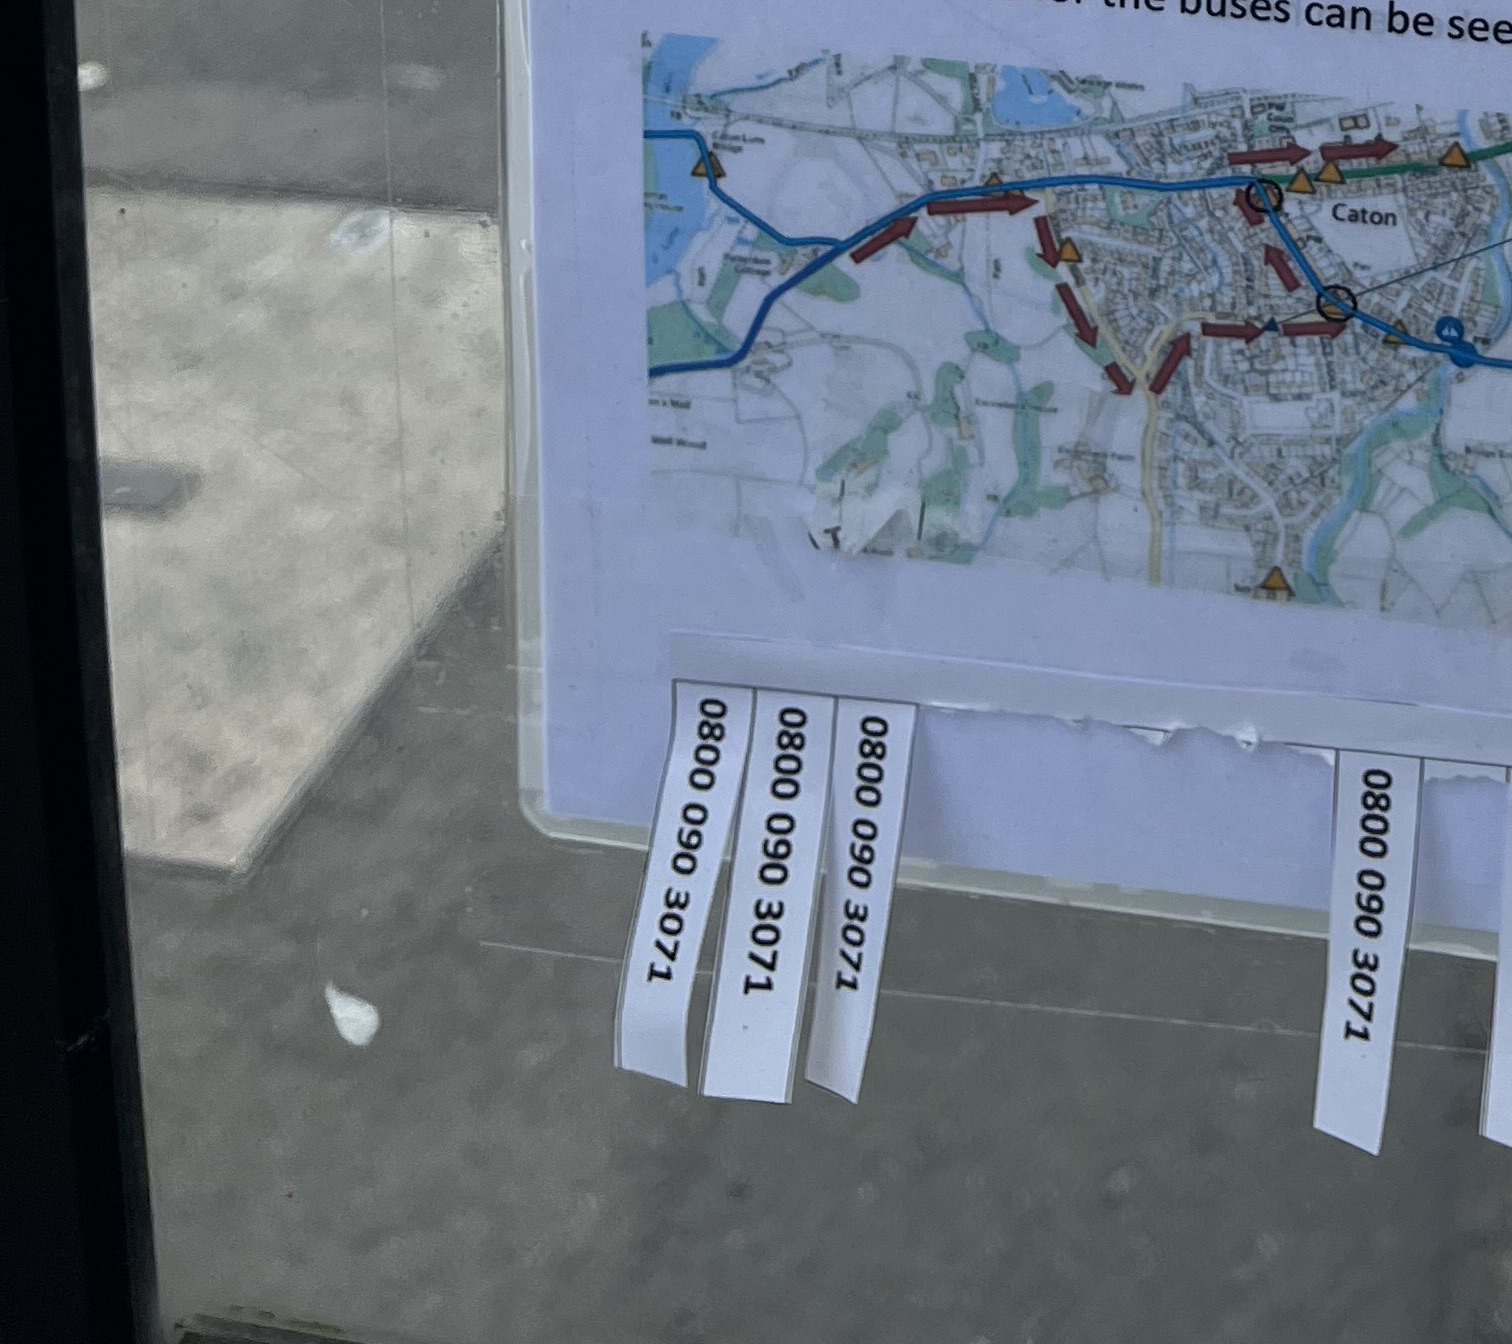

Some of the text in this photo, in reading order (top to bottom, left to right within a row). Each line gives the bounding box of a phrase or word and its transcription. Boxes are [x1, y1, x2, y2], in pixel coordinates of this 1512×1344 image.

[1305, 2, 1372, 31] can
[1388, 0, 1434, 37] be
[1331, 202, 1398, 228] Caton
[648, 698, 727, 981] 0800 090 3071
[744, 708, 807, 994] 0800 090 3071
[1345, 770, 1392, 1041] 0800 090 3071
